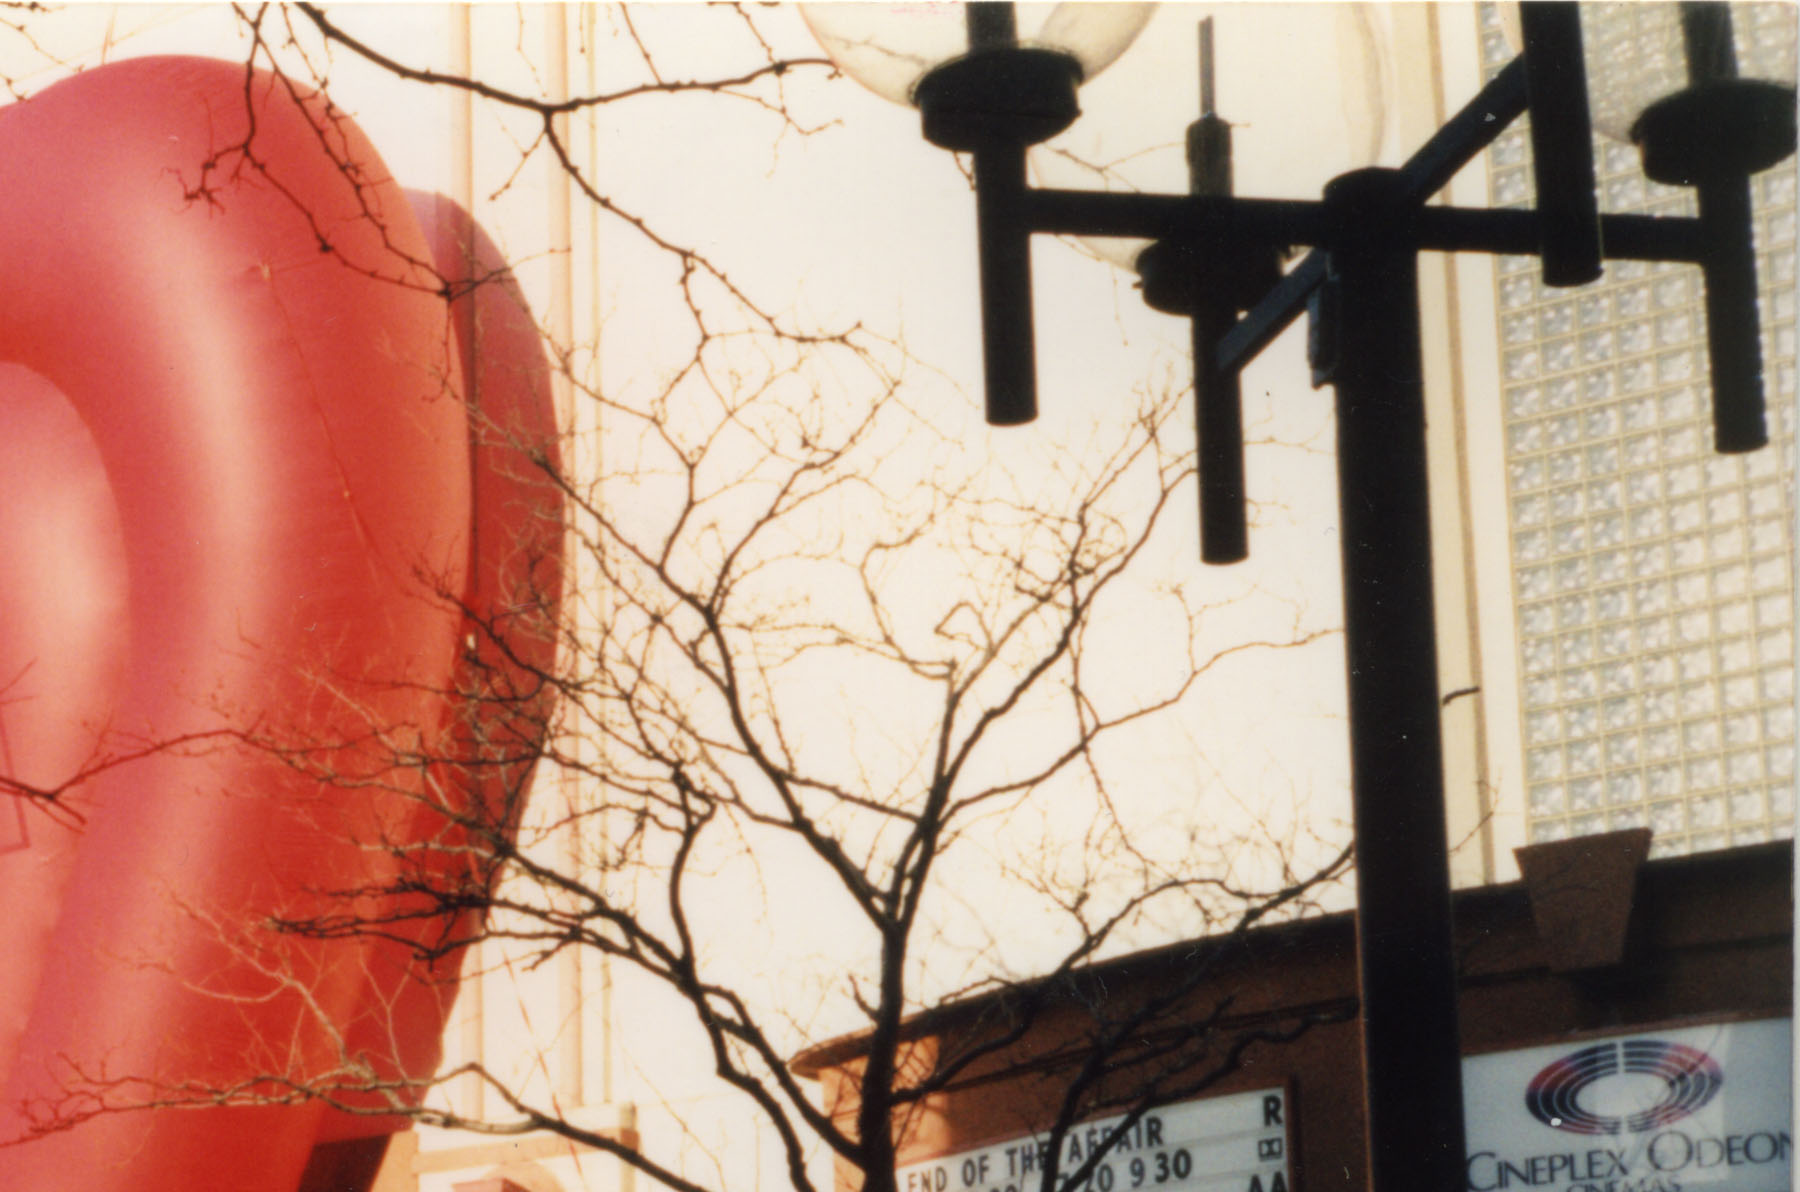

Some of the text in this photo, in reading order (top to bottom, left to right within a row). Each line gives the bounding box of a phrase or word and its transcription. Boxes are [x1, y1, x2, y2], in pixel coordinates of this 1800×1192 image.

[1264, 1096, 1283, 1126] R
[963, 1153, 989, 1187] OF
[1466, 1149, 1630, 1192] CINEPLEX
